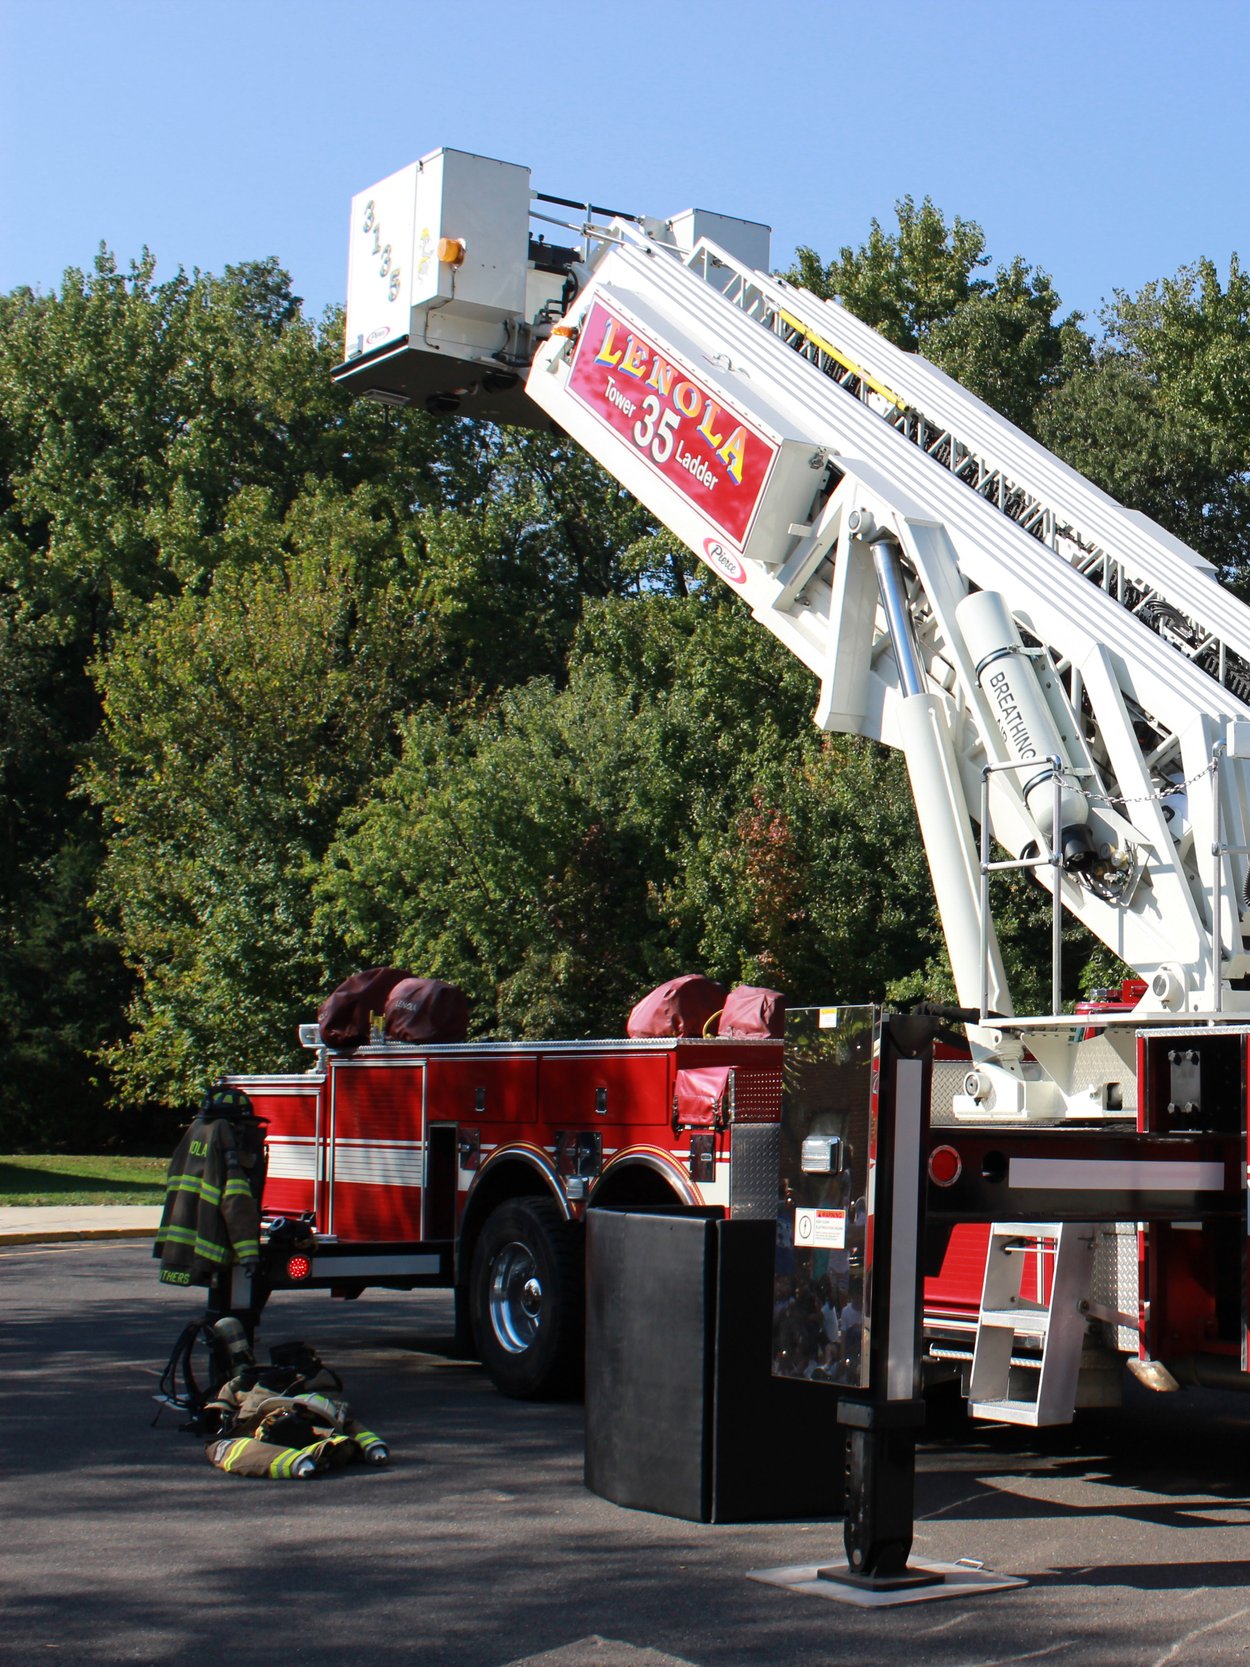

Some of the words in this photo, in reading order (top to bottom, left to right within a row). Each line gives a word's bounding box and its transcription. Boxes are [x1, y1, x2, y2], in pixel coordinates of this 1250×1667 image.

[363, 199, 401, 302] 3135
[595, 317, 748, 486] LENOLA
[604, 376, 637, 418] Tower
[632, 394, 682, 464] 35
[674, 440, 719, 491] Ladder
[710, 544, 737, 575] Pierce
[989, 672, 1037, 760] BREATHING
[160, 1269, 190, 1285] THERS
